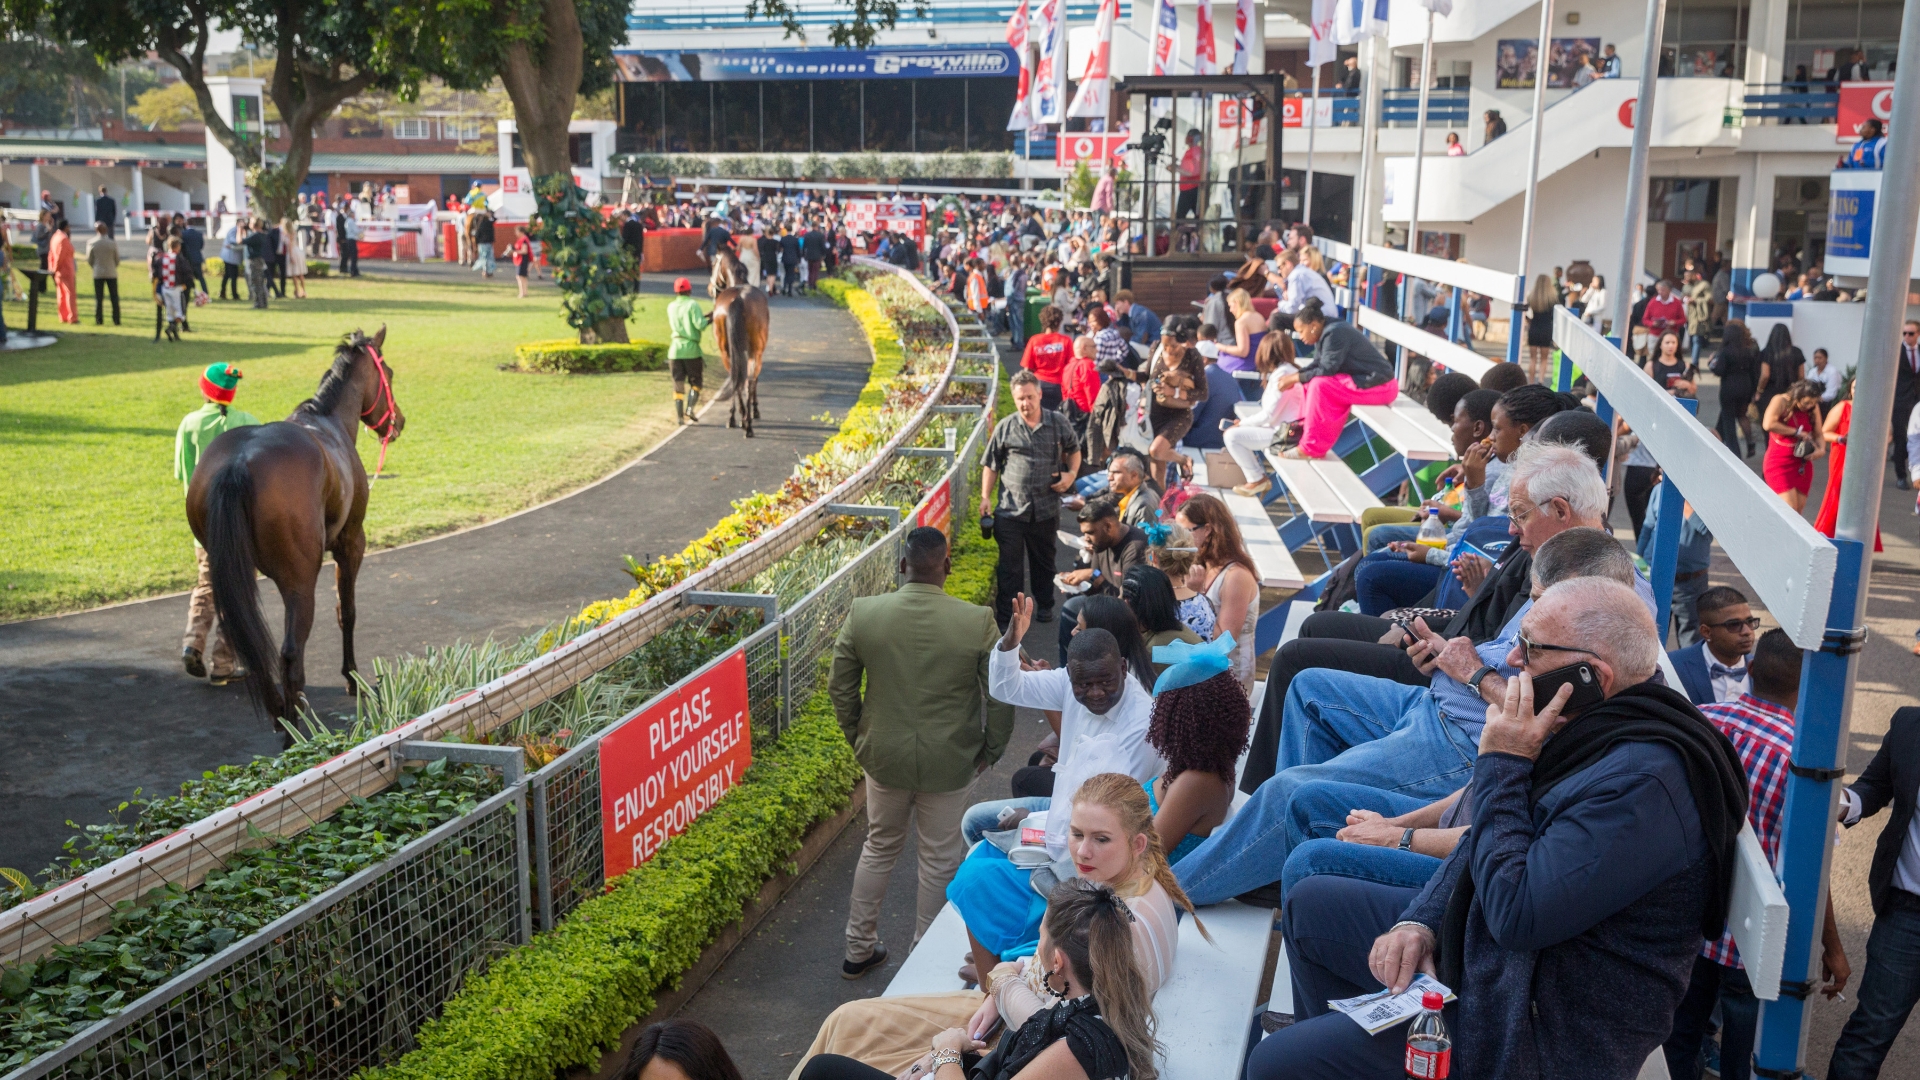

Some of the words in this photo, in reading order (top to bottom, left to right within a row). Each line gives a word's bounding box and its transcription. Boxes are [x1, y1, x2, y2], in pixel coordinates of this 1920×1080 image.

[775, 63, 866, 75] Champions
[873, 54, 1003, 74] Greyville
[649, 686, 712, 760] PLEASE
[613, 765, 667, 834] ENJOY
[669, 711, 743, 789] YOURSELF
[632, 759, 735, 867] RESPONSIBLY
